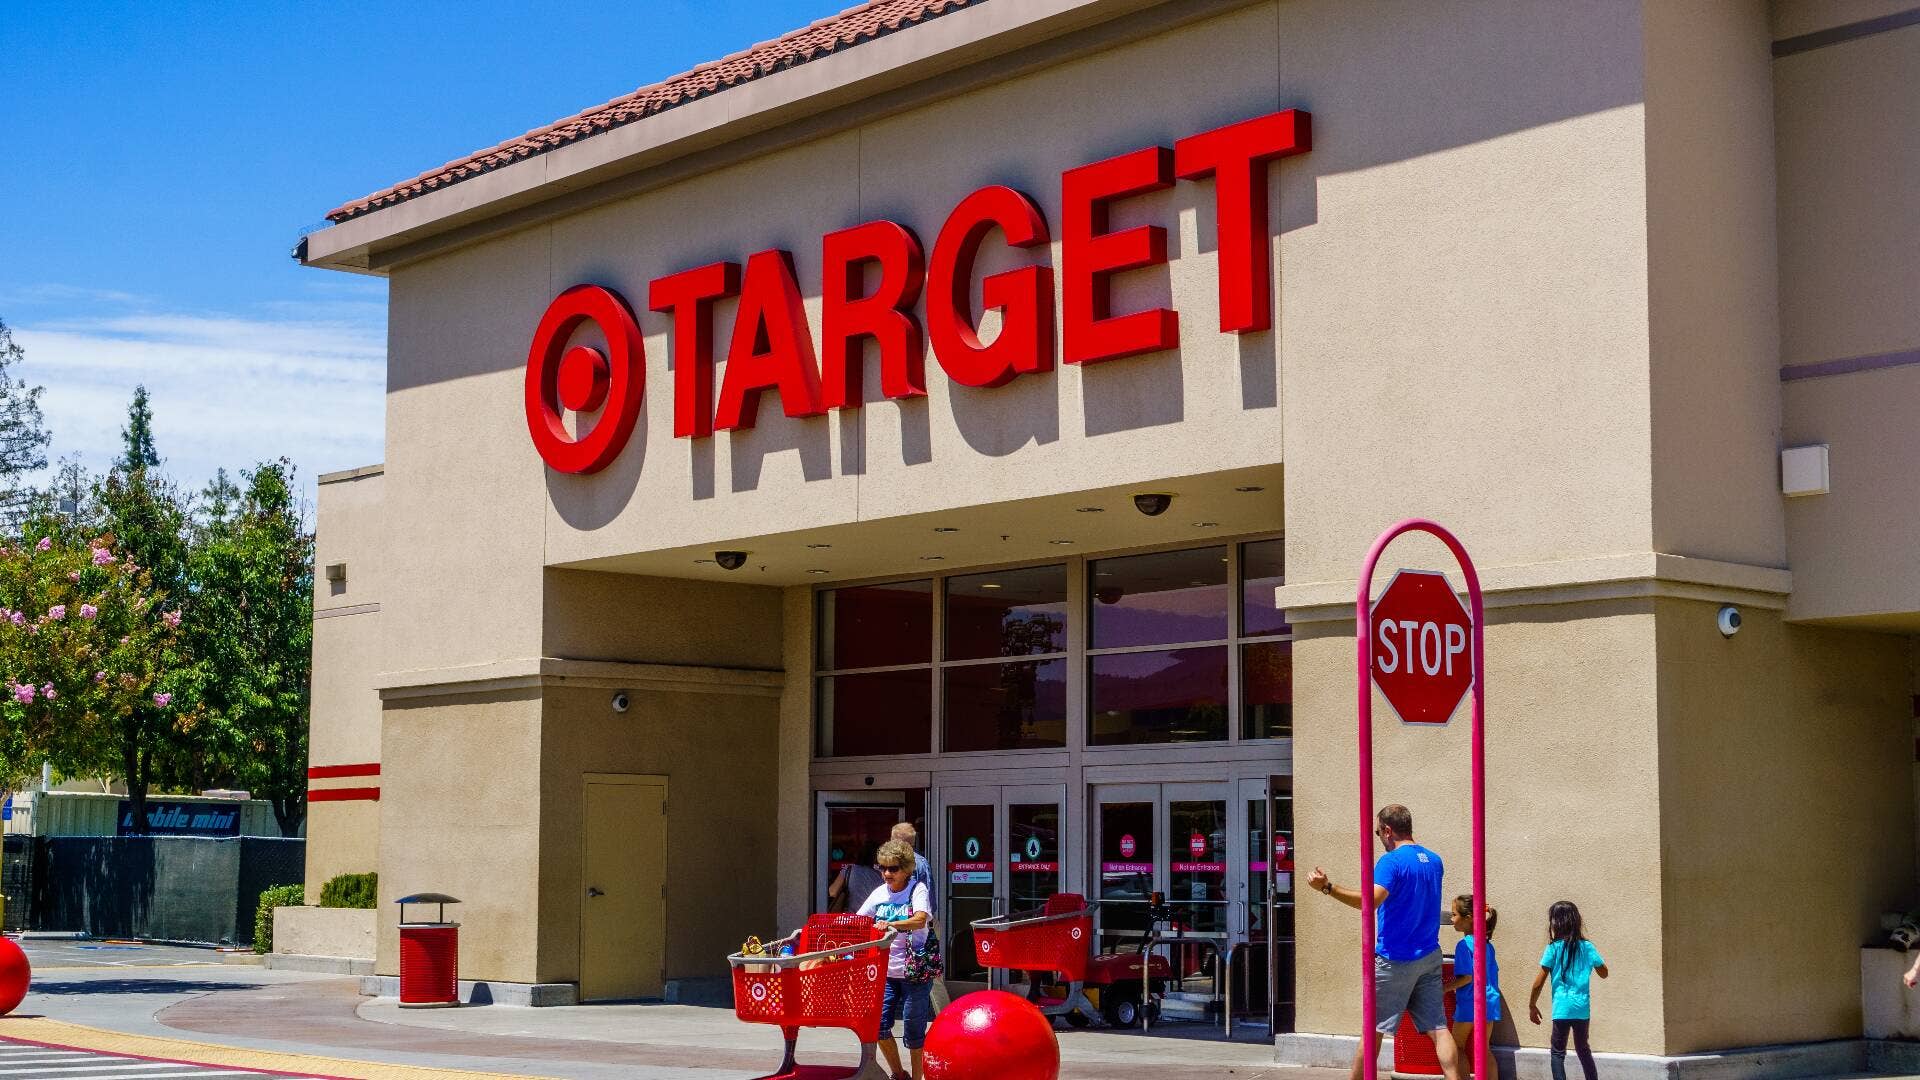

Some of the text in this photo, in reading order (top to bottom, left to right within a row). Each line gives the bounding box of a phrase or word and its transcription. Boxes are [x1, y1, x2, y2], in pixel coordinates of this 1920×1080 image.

[649, 109, 1312, 439] TARGET
[1378, 618, 1466, 676] STOP
[191, 811, 235, 829] mini
